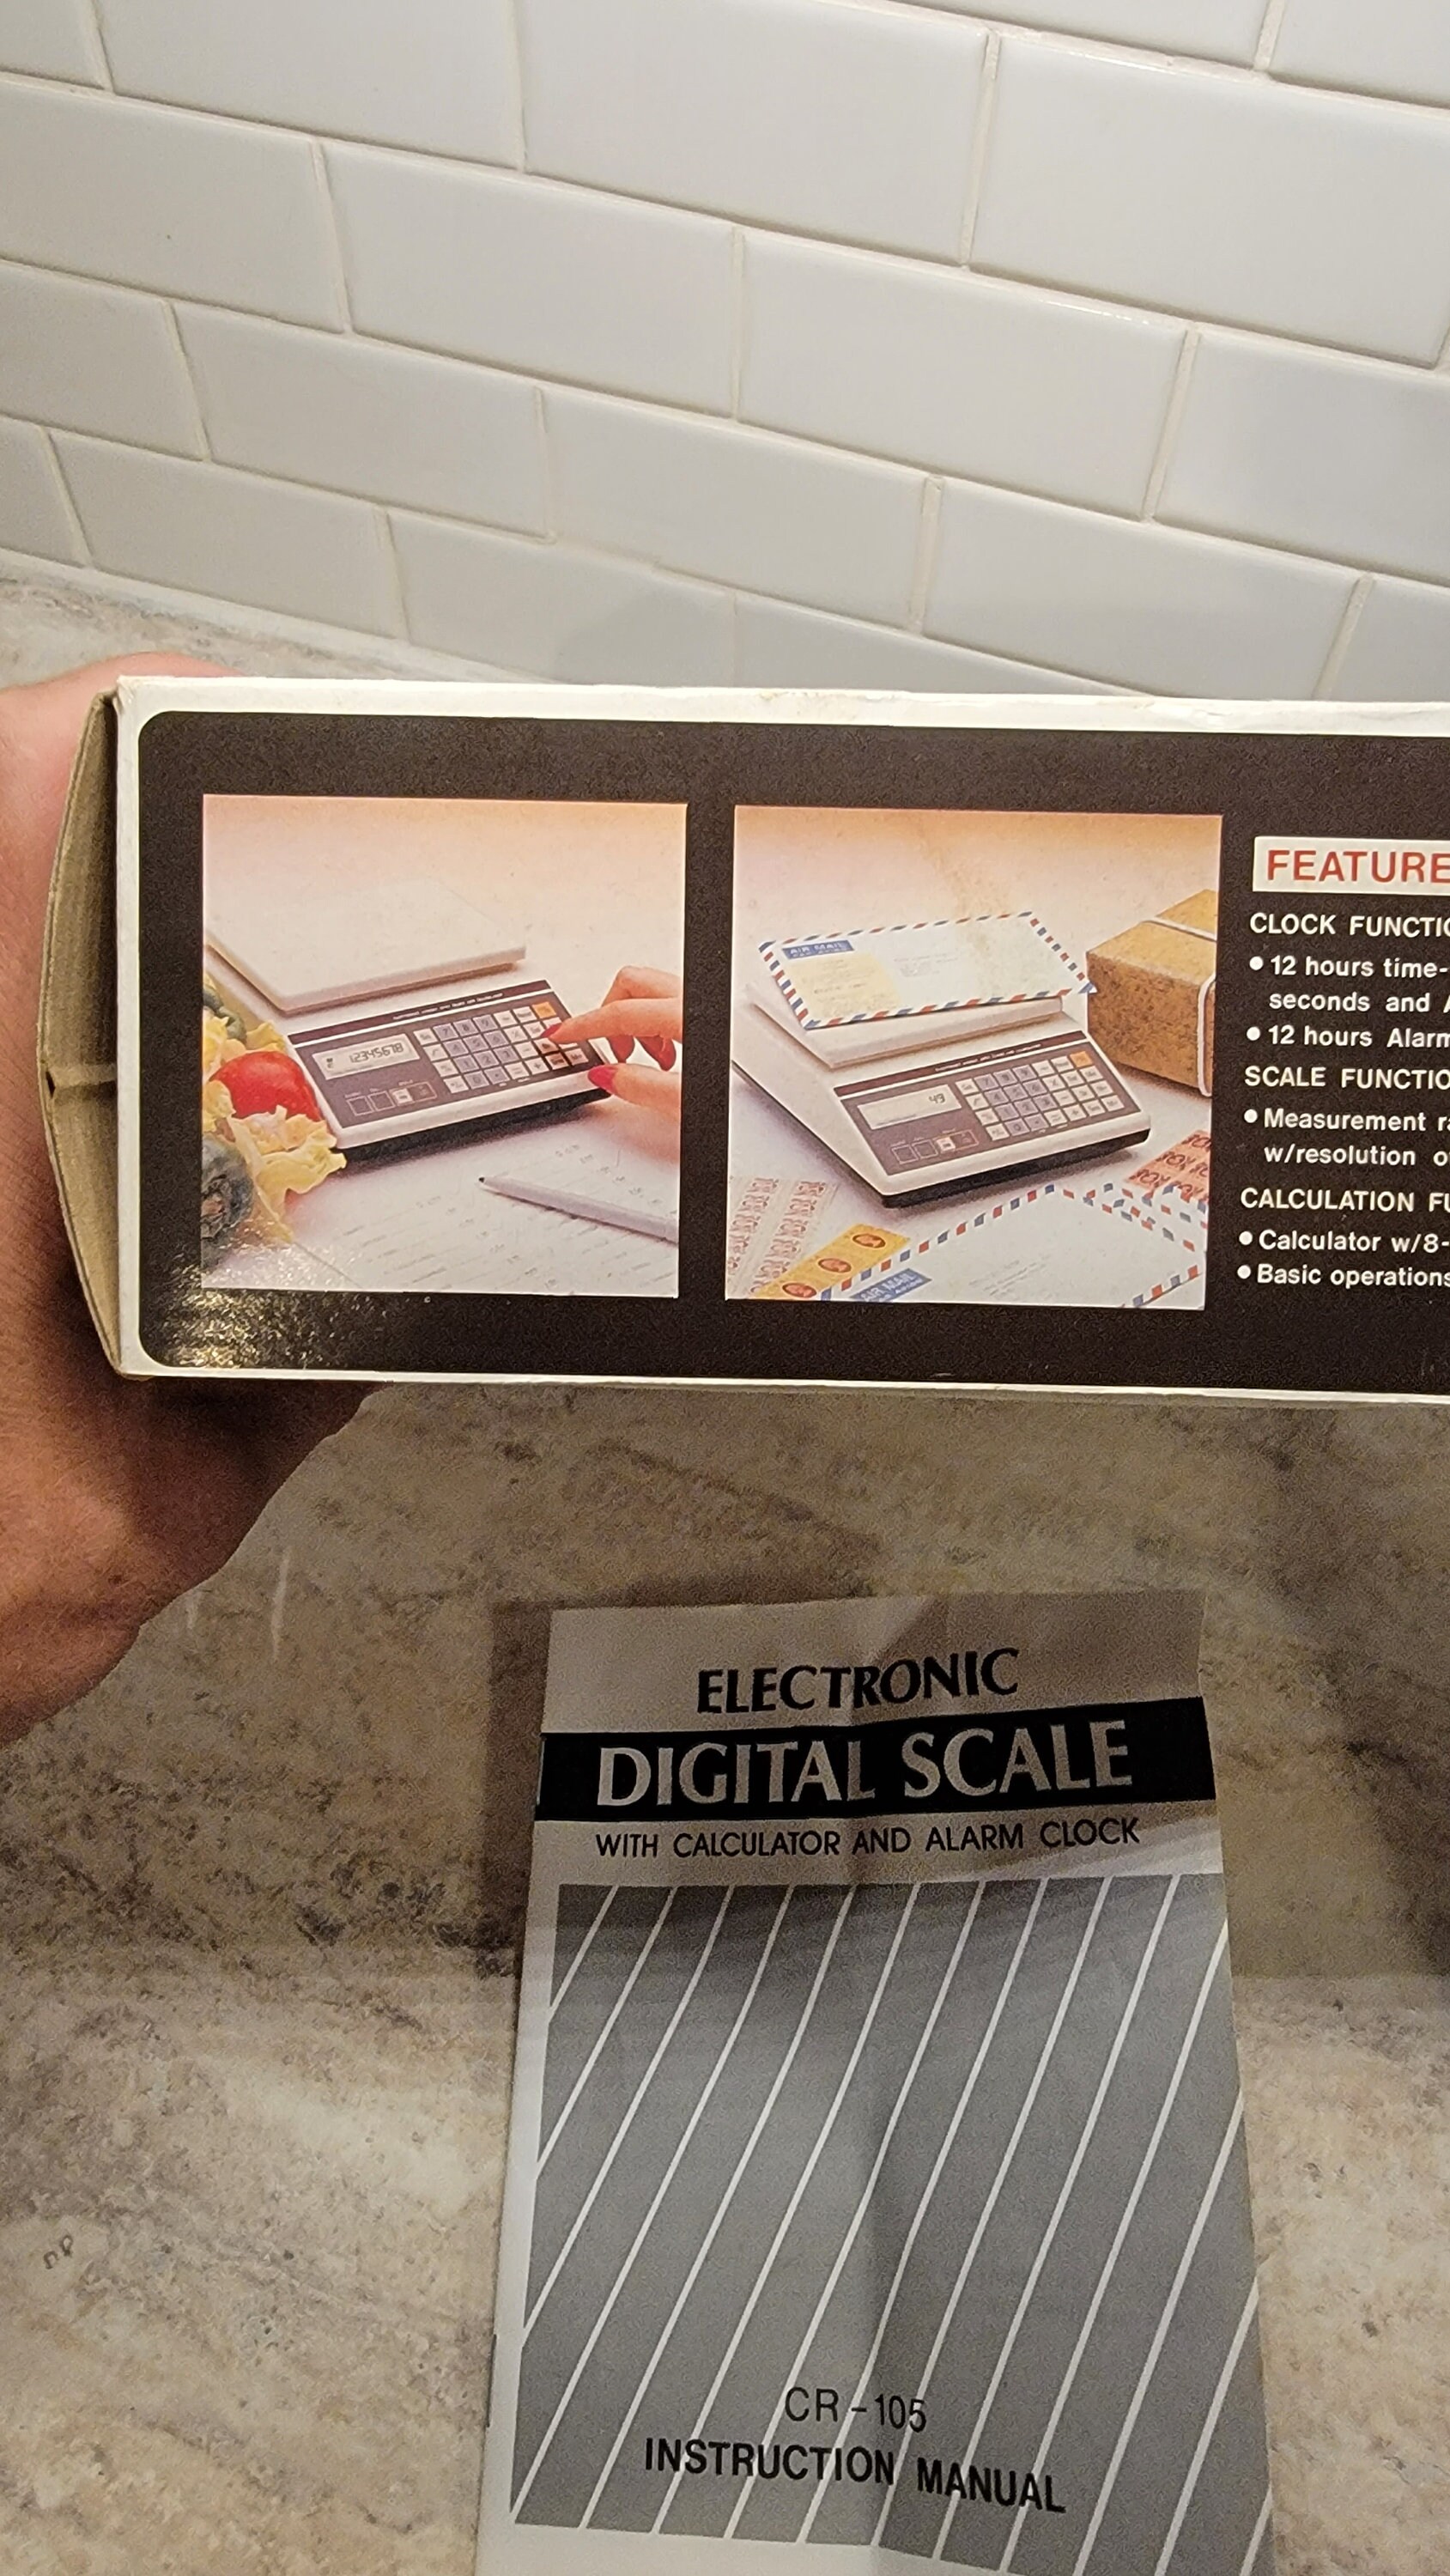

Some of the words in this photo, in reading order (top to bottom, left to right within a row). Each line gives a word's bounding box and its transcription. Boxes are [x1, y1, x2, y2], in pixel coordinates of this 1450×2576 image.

[1266, 849, 1450, 884] FEATURE
[1250, 912, 1337, 935] CLOCK
[1271, 954, 1296, 975] 12
[1305, 956, 1374, 977] hours
[1269, 991, 1370, 1012] seconds
[1385, 992, 1430, 1012] and
[1268, 1024, 1295, 1045] 12
[1304, 1025, 1373, 1047] hours
[349, 1042, 404, 1063] 12345678
[1244, 1065, 1326, 1087] SCALE
[1341, 1068, 1450, 1090] FUNCTIO
[1264, 1108, 1427, 1132] Measurement
[1438, 1116, 1450, 1132] r
[1264, 1143, 1416, 1166] w/resolution
[1241, 1187, 1415, 1212] CALCULATION
[1259, 1229, 1381, 1252] Calculator
[1391, 1233, 1450, 1254] w/8-
[1257, 1263, 1321, 1285] Basic
[696, 1647, 1020, 1714] ELECTRONIC
[597, 1740, 876, 1807] DIGITAL
[900, 1719, 1132, 1799] SCALE
[595, 1833, 658, 1858] WITH
[673, 1830, 840, 1858] CALCULATOR
[852, 1826, 910, 1855] AND
[925, 1822, 1023, 1852] ALARM
[1040, 1816, 1141, 1849] CLOCK
[645, 2437, 895, 2485] INSTRUCTION
[917, 2457, 1066, 2514] MANUAL
